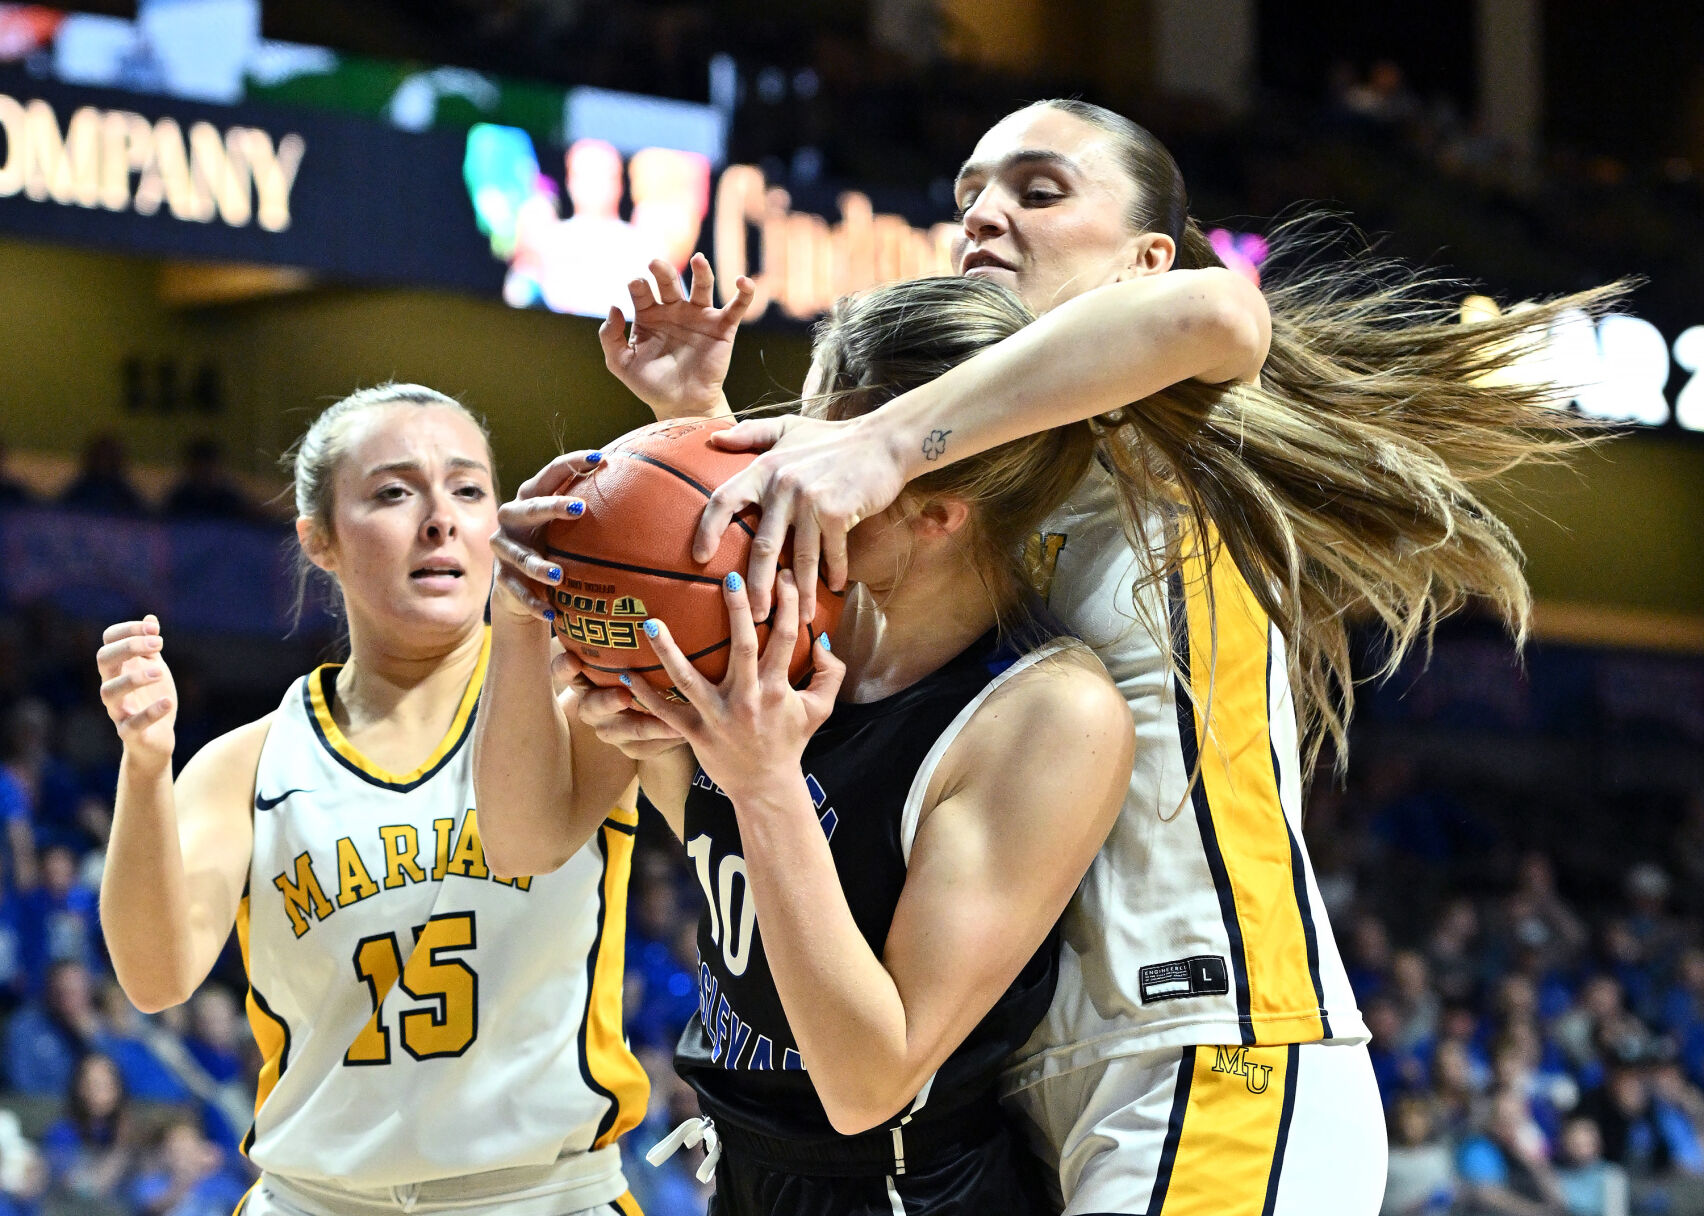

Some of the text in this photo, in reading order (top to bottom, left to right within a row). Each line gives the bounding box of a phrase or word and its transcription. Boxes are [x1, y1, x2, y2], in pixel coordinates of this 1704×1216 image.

[274, 808, 535, 939] MARIA
[687, 833, 757, 977] 10
[343, 910, 479, 1067] 15
[1202, 967, 1213, 982] L
[1212, 1045, 1273, 1094] MU
